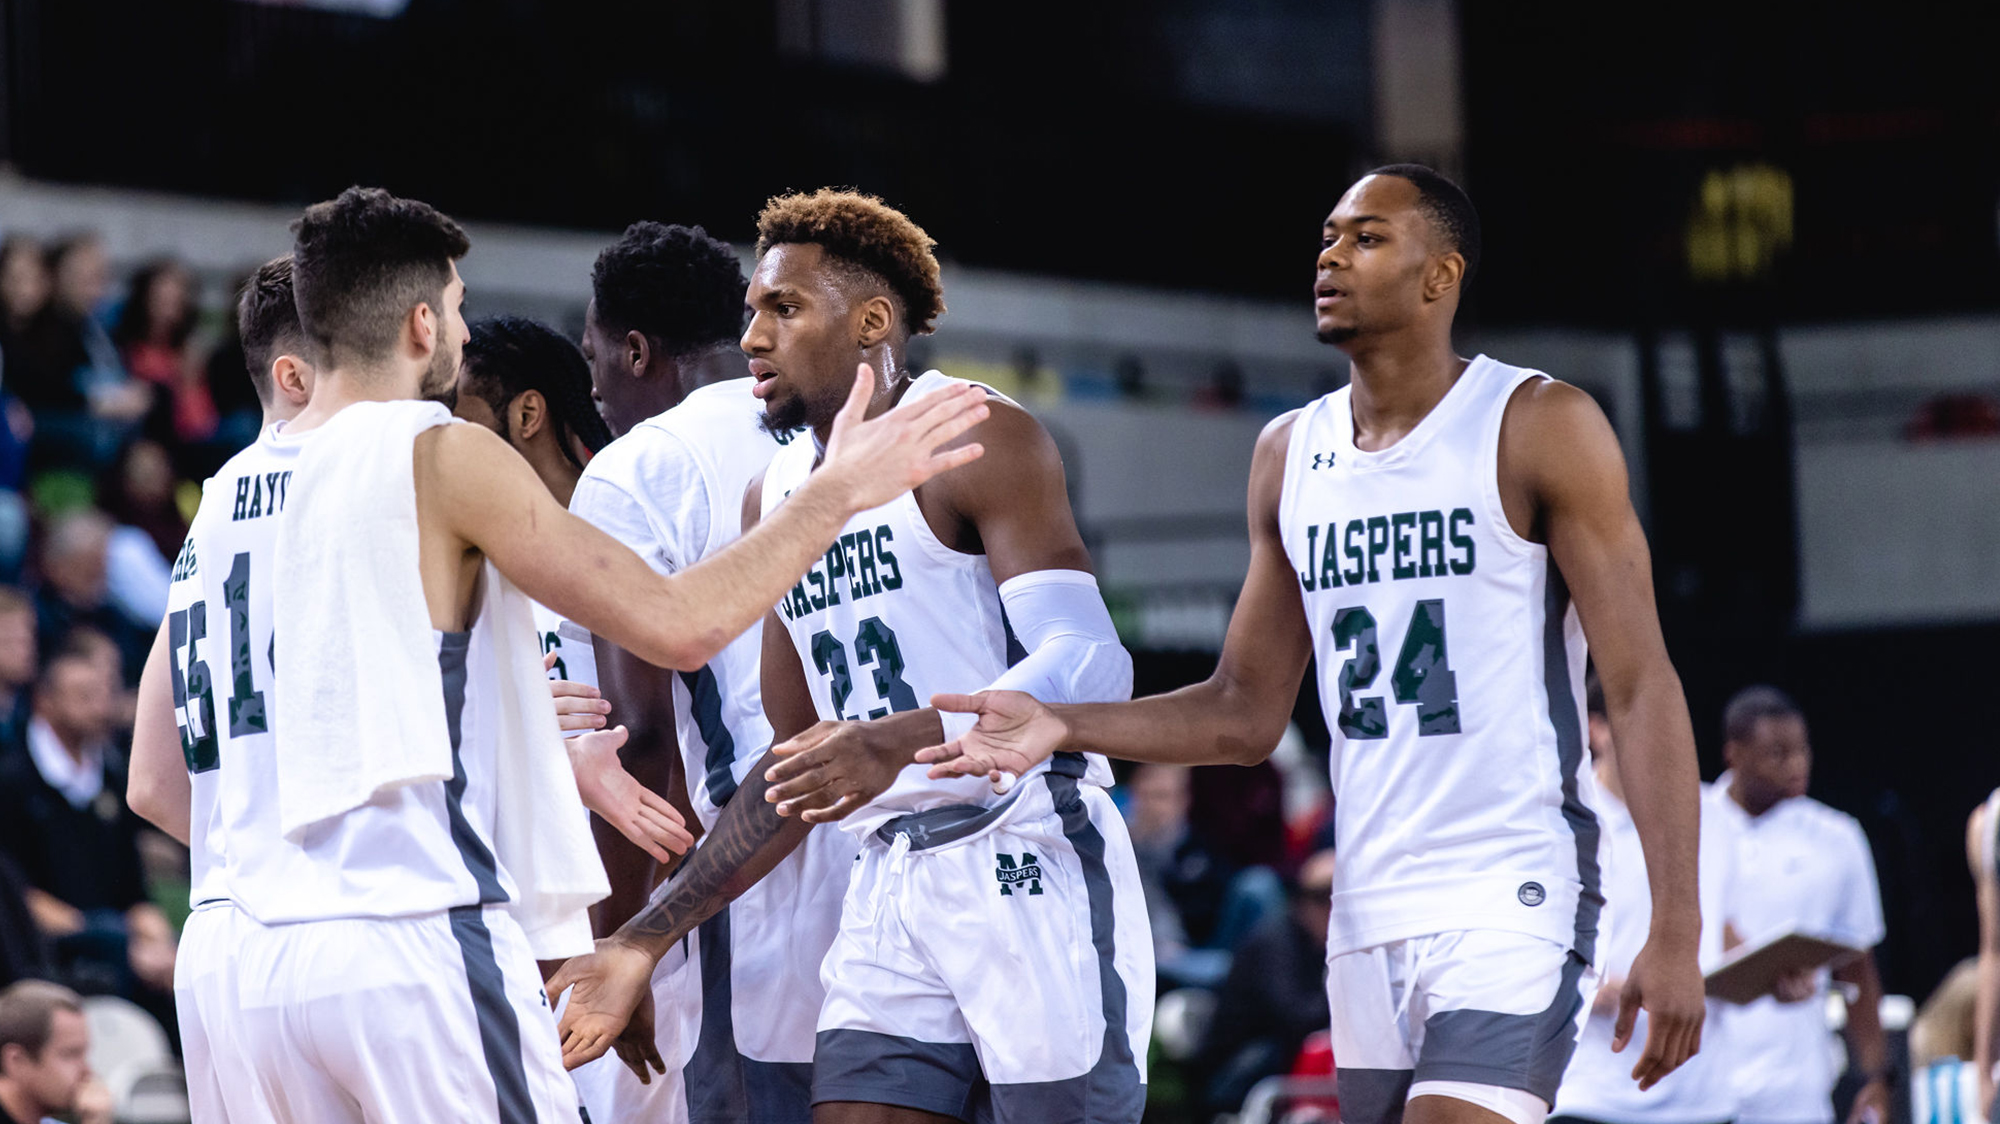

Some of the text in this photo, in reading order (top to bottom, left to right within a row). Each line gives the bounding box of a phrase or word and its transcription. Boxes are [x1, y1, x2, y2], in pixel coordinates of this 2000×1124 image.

[232, 470, 293, 521] HAY
[1301, 507, 1476, 592] JASPERS
[223, 552, 275, 739] 1
[811, 616, 920, 721] 23
[1331, 598, 1462, 740] 24
[999, 867, 1039, 882] JASPERS
